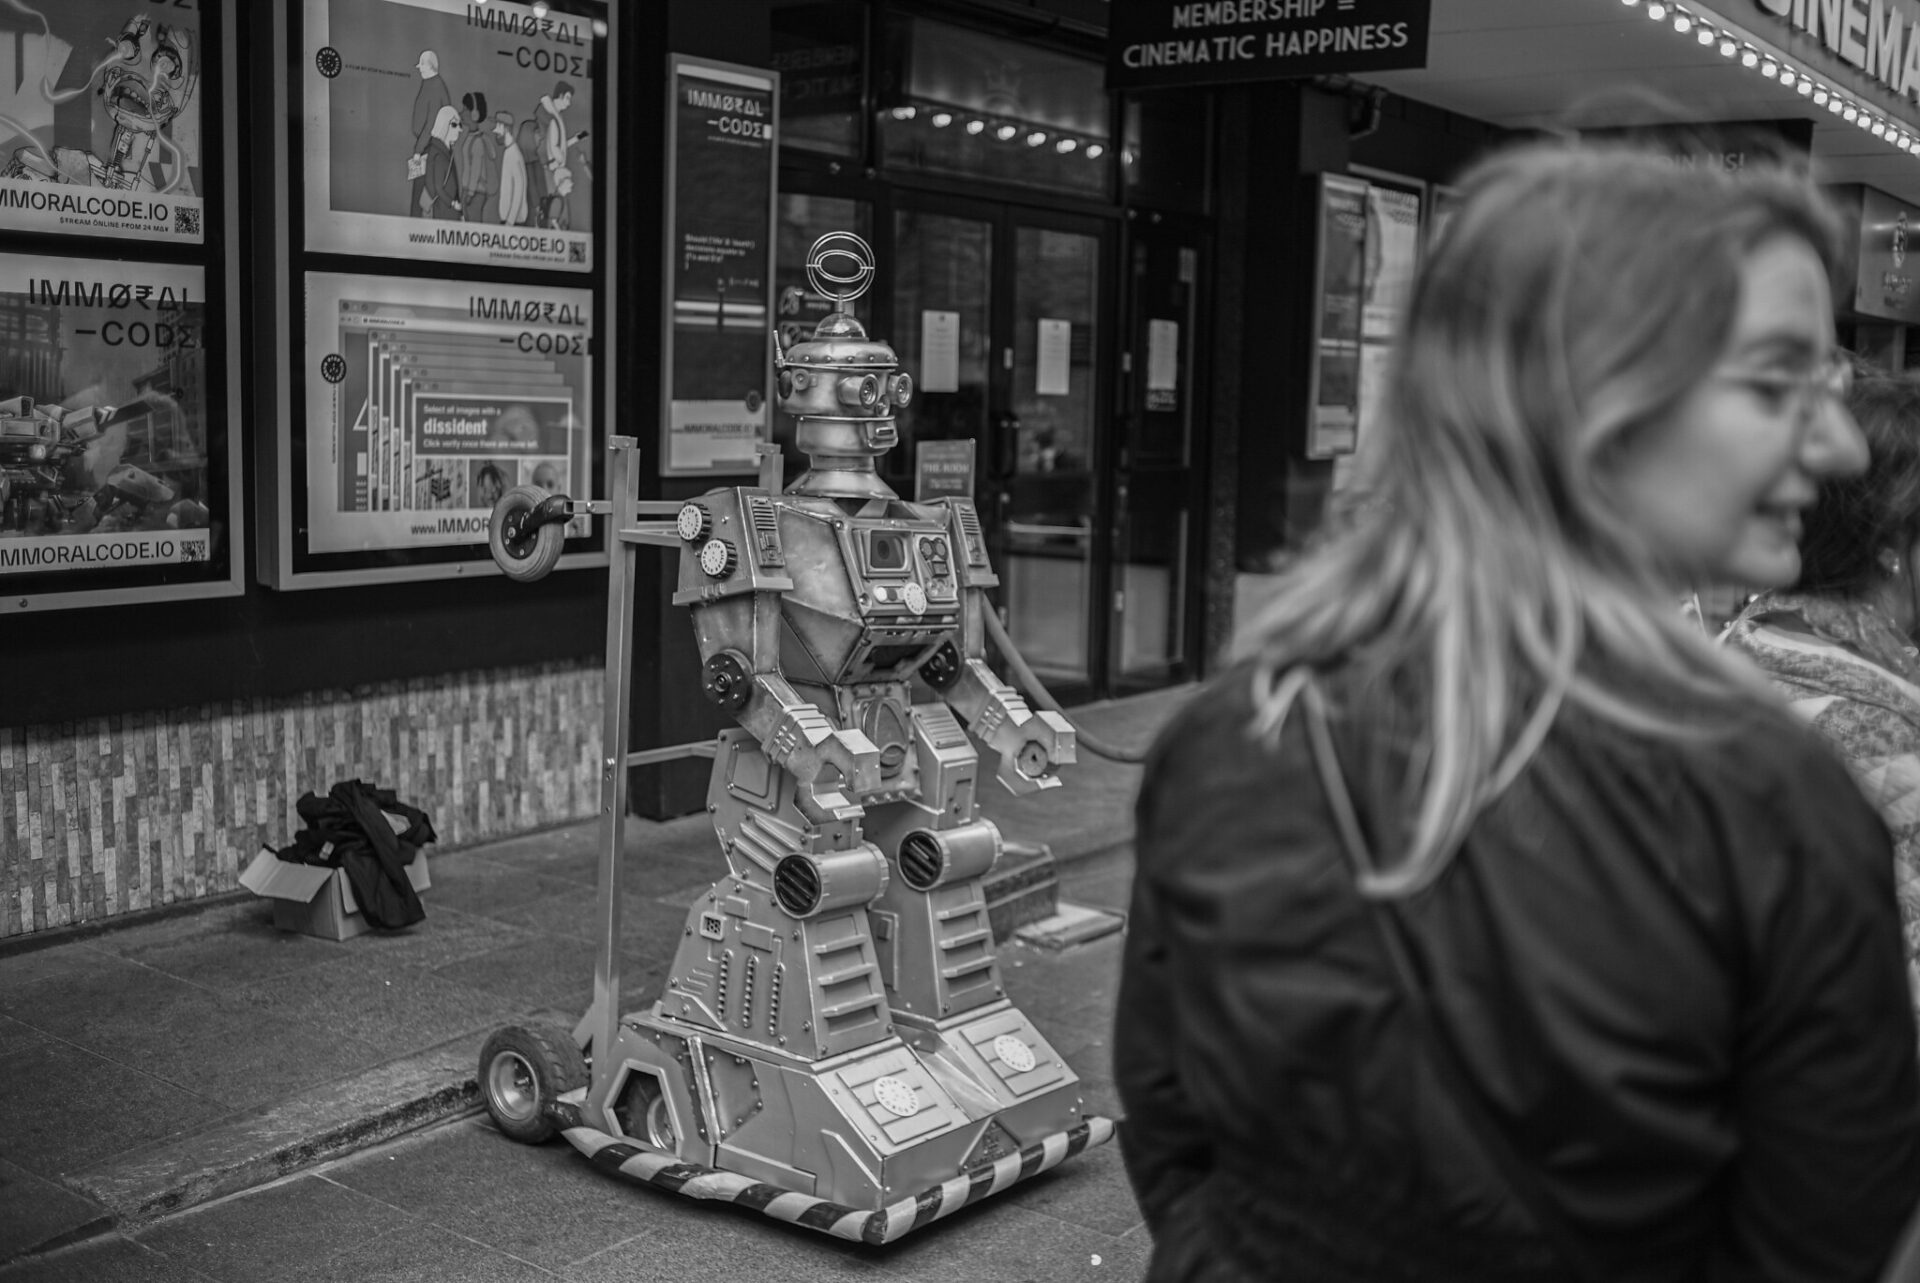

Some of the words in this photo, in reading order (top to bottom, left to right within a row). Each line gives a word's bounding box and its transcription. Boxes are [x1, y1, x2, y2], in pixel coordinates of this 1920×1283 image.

[1172, 0, 1326, 29] MEMBERSHIP
[1123, 35, 1256, 68] CINEMATIC
[1265, 22, 1409, 57] HAPPINESS
[409, 228, 565, 253] www.IMMORALCODE.IO
[423, 417, 488, 435] dissident
